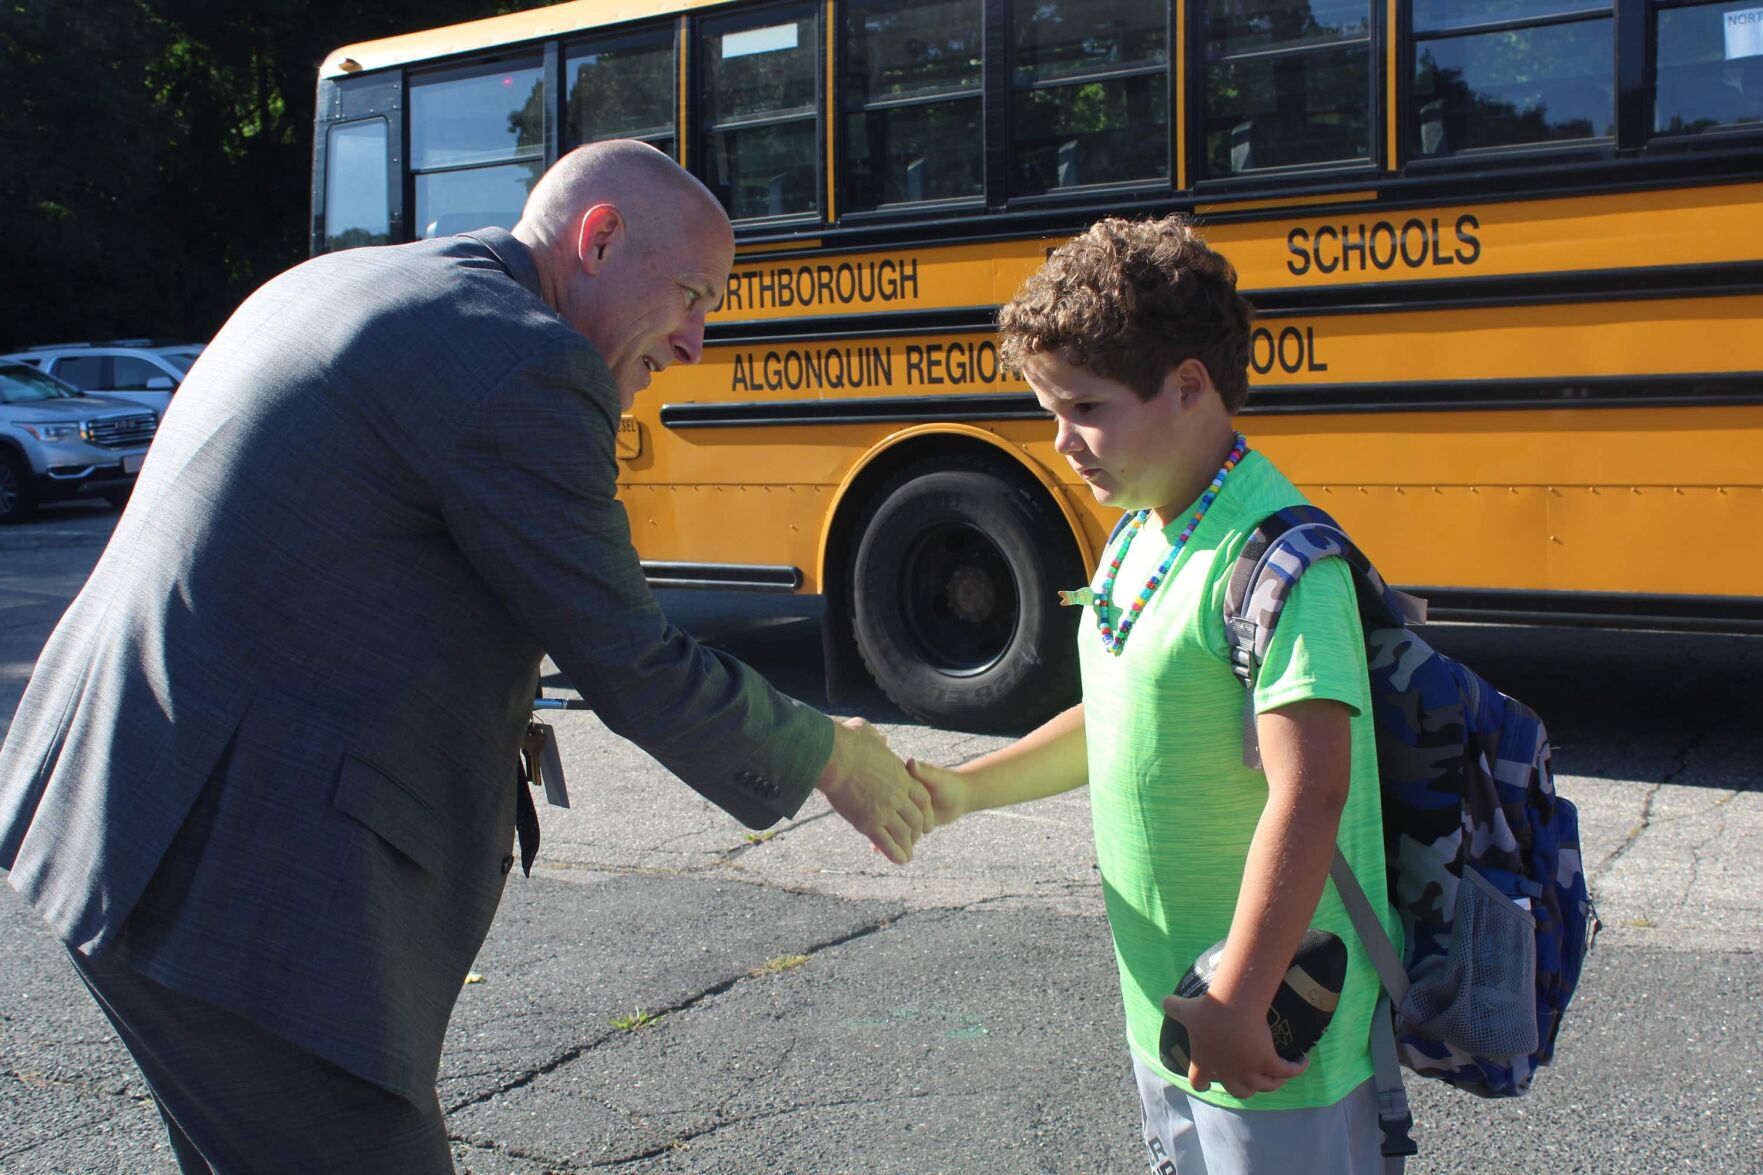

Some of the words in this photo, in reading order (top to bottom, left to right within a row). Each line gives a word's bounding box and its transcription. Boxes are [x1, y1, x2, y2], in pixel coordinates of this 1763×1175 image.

[706, 258, 919, 313] RTHBOROUGH
[1287, 214, 1481, 276] SCHOOLS
[732, 347, 893, 392] ALGONQUIN
